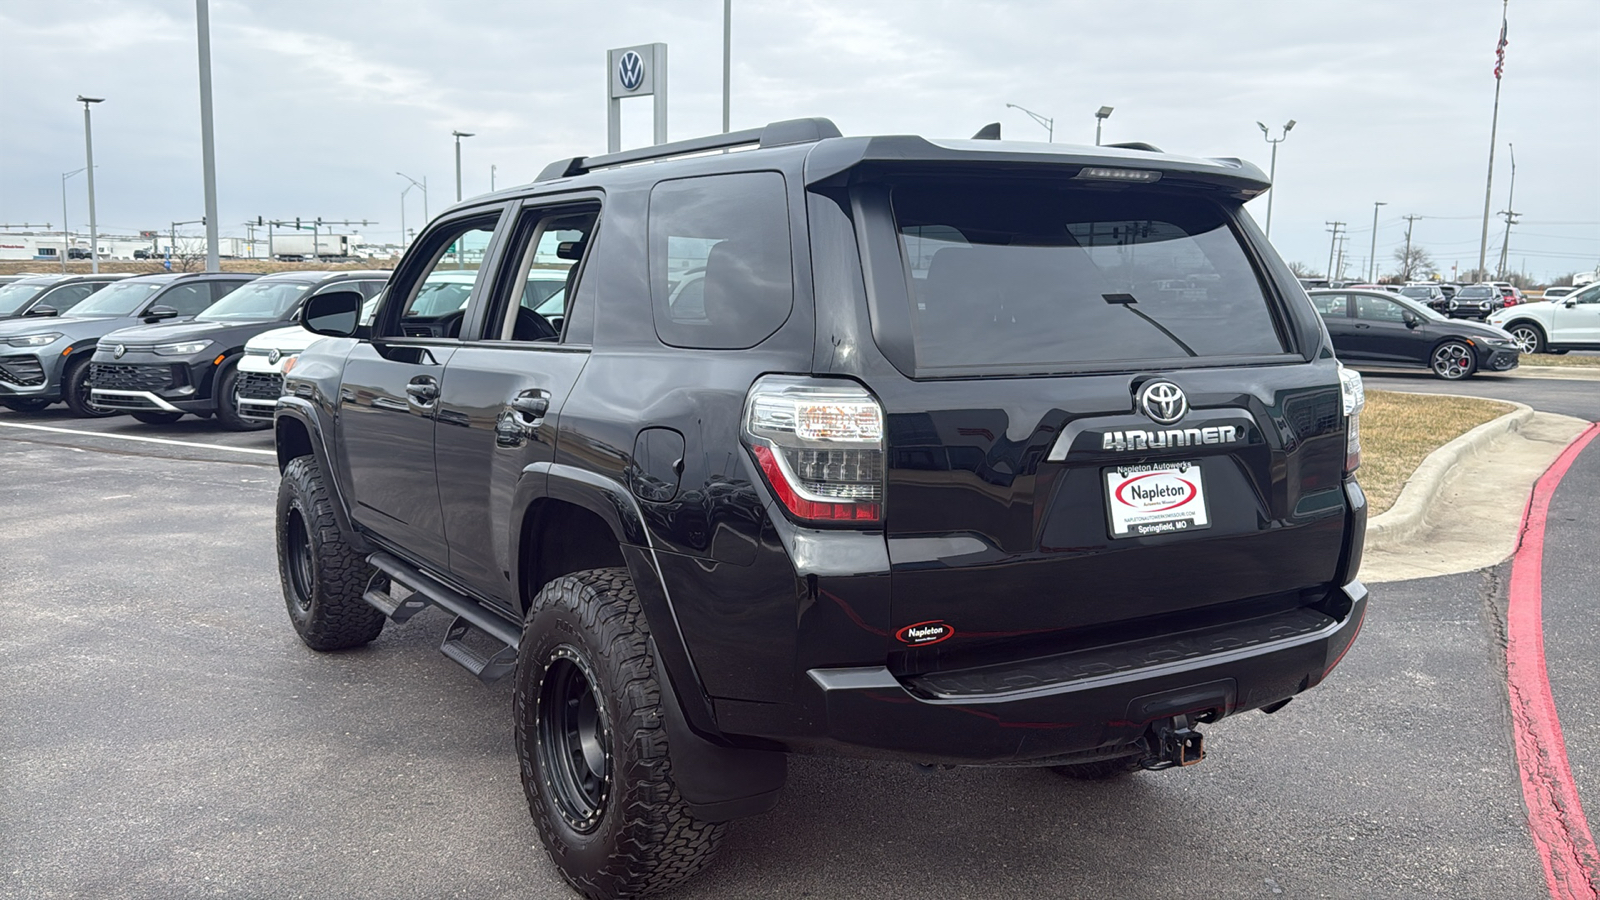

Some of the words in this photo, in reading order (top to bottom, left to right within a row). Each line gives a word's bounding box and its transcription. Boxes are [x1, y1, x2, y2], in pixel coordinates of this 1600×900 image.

[1103, 426, 1236, 451] 4RUNNER
[1117, 464, 1151, 473] Napleton
[1153, 461, 1191, 470] Autowerks
[1131, 484, 1184, 501] Napleton
[1138, 522, 1175, 534] Springfield,
[908, 626, 943, 637] Napleton
